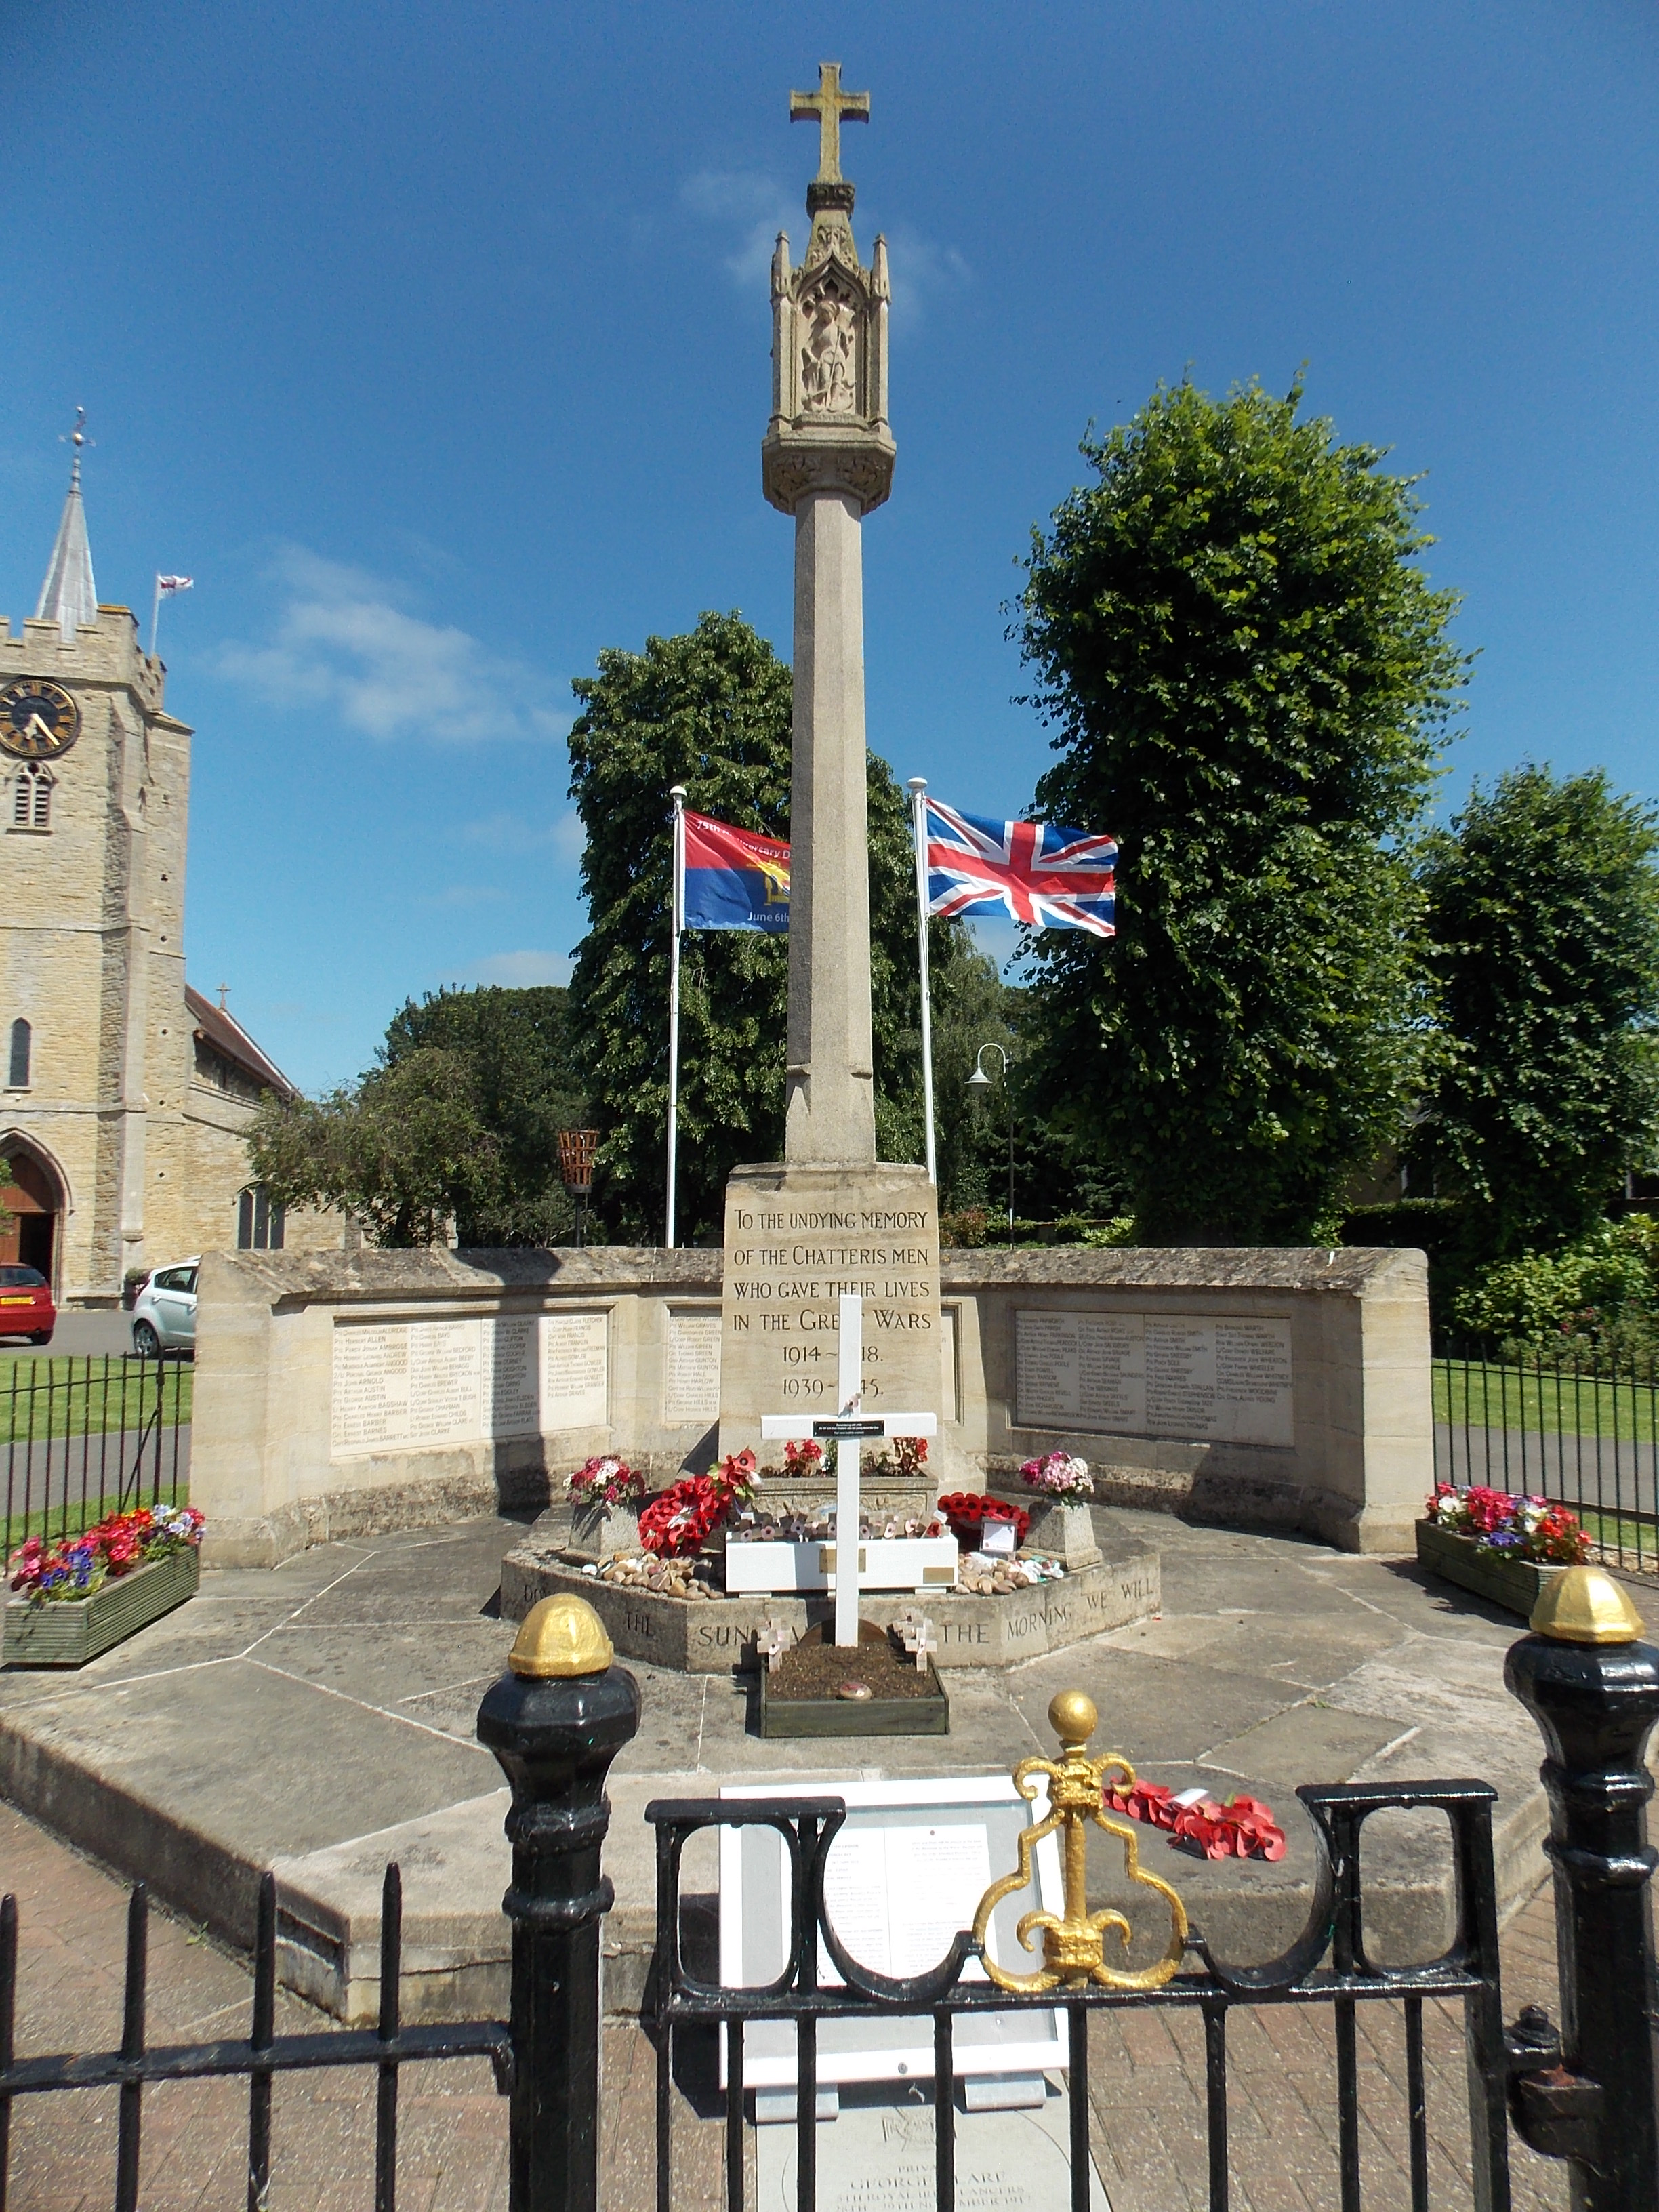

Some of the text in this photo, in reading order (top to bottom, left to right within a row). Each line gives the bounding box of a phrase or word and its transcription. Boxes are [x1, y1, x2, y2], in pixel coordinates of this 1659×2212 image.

[697, 821, 720, 832] 75th
[747, 912, 790, 922] June 6th
[735, 1209, 928, 1229] TO THE UNDYING MEMORY
[734, 1246, 928, 1265] OF THE CHATTERIS MEN
[734, 1282, 929, 1299] WHO GAVE THEIR LIVES
[734, 1309, 931, 1330] IN THE GRE WARS
[783, 1346, 821, 1366] 1914
[783, 1379, 823, 1399] 1939
[378, 1400, 407, 1408] BAGSHAW
[384, 1408, 407, 1416] BARBER
[363, 1427, 387, 1435] BARNES
[1008, 1577, 1154, 1640] MORNING WE WILL
[700, 1624, 990, 1646] SUN THE
[851, 2172, 1006, 2190] GEORGE LARE
[867, 2192, 912, 2202] ROYAL
[919, 2190, 935, 2199] IRI
[959, 2186, 1025, 2197] LANCERS
